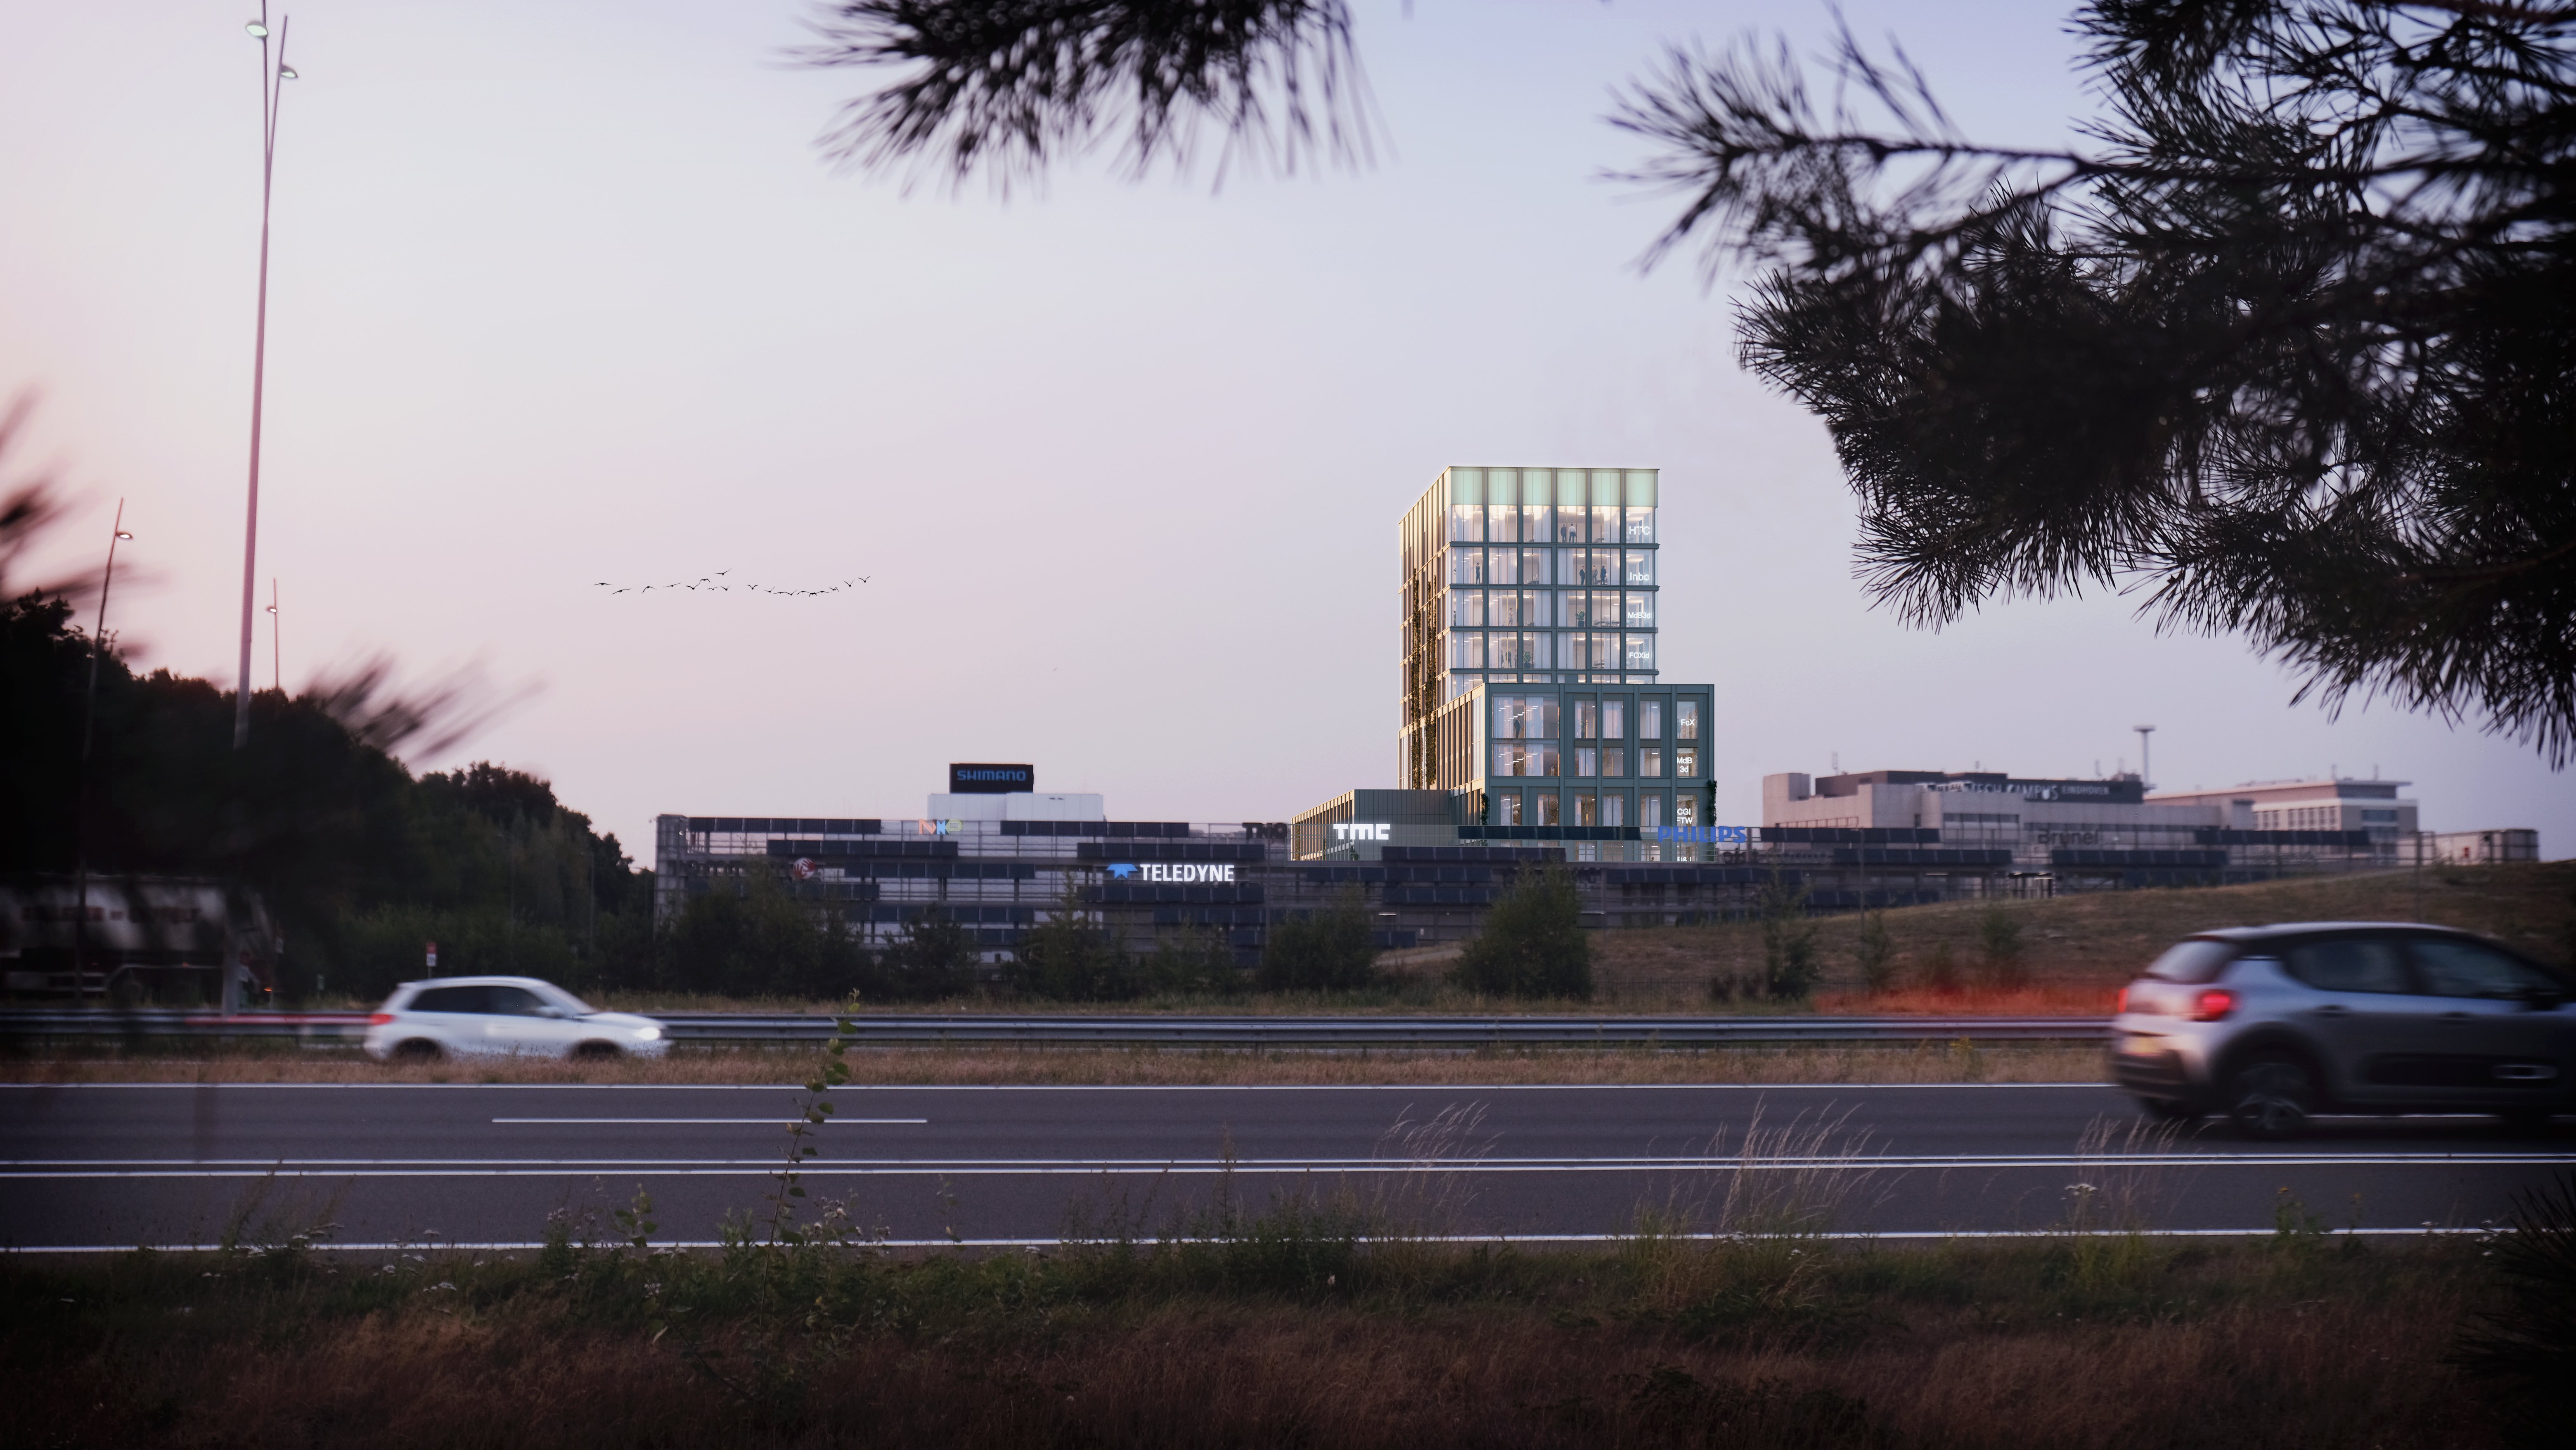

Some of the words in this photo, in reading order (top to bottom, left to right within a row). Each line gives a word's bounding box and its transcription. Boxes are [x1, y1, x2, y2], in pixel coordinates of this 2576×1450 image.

[1629, 526, 1650, 535] HTC
[1630, 572, 1650, 581] Inbo
[957, 770, 1026, 781] SHIMANO
[1658, 826, 1746, 843] PHILIPS
[1140, 864, 1234, 882] TELEDYNE
